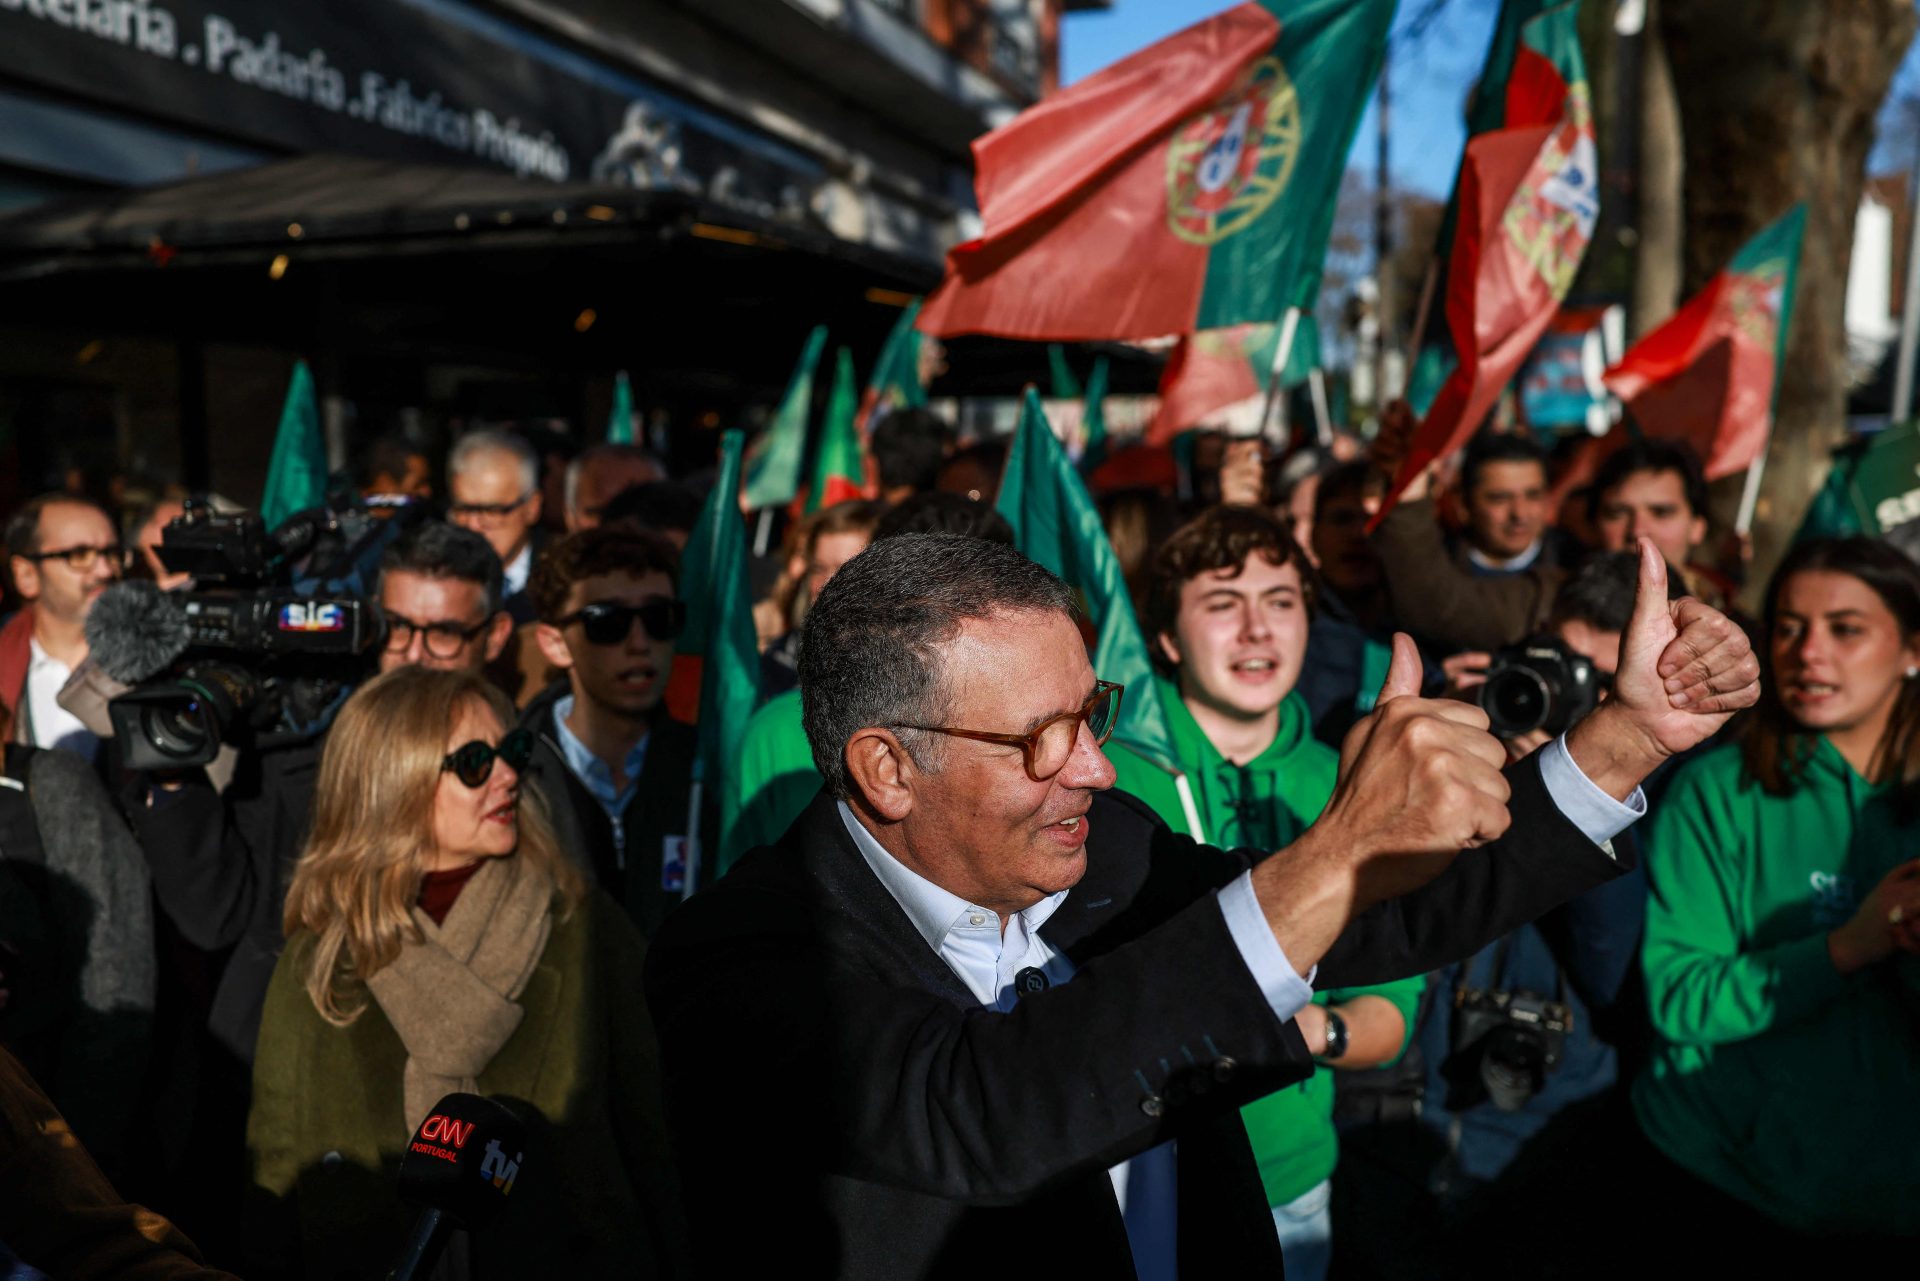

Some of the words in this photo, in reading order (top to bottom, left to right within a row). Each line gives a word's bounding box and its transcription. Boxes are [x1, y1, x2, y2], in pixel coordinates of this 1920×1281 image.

[205, 14, 344, 111] Padaria
[410, 1142, 457, 1163] PORTUGAL
[421, 1114, 476, 1149] CNN
[480, 1139, 523, 1196] tvi
